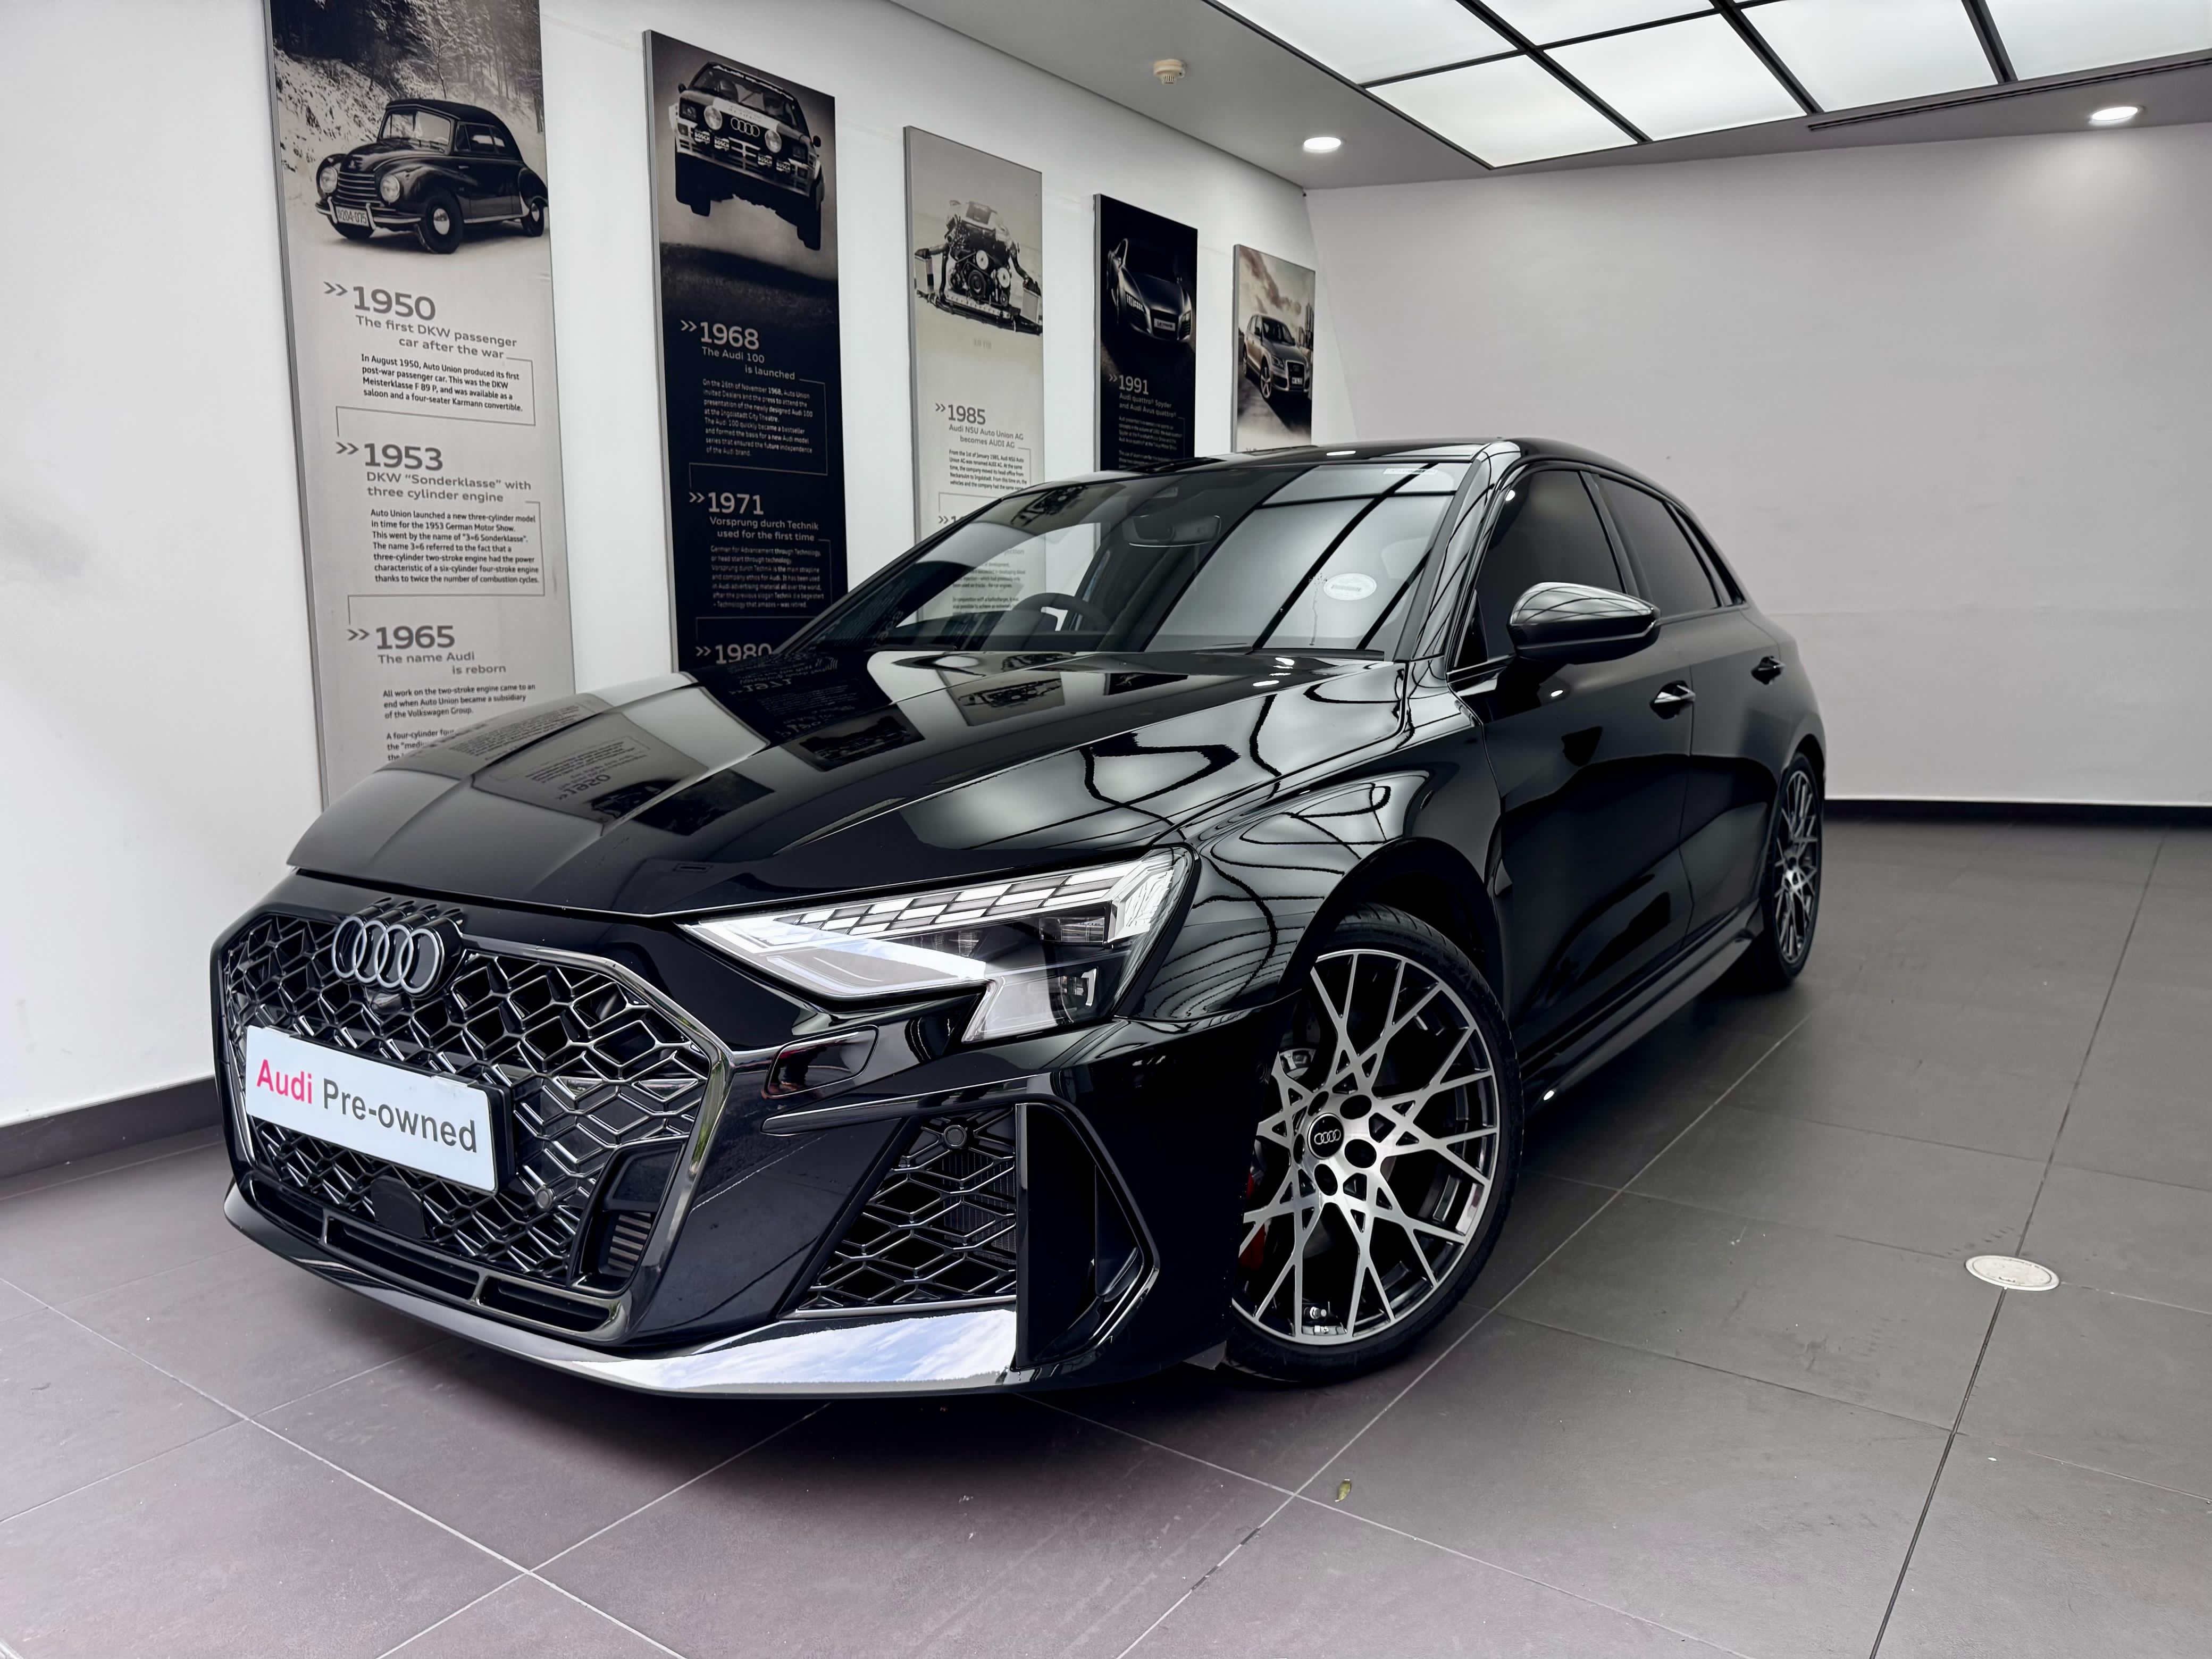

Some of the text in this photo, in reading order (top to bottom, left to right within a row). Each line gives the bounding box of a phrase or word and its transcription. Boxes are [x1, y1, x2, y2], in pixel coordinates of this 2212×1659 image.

[353, 286, 435, 321] 1950
[355, 315, 517, 349] The first DKW passenger
[701, 322, 759, 349] 1968
[399, 338, 504, 359] car after the war
[702, 347, 765, 363] The Audi 100
[371, 355, 398, 367] August
[423, 361, 440, 371] Auto
[441, 364, 462, 373] Union
[464, 366, 495, 379] produced
[506, 371, 519, 380] first
[745, 365, 795, 380] is launched
[363, 376, 413, 389] Meisterklasse
[440, 385, 453, 393] and
[469, 388, 499, 398] available
[397, 371, 433, 382] passenger
[448, 375, 463, 384] This
[479, 378, 490, 387] the
[491, 380, 508, 389] DKW
[1119, 374, 1149, 395] 1991
[364, 388, 388, 397] saloon
[390, 390, 404, 399] and
[452, 397, 483, 407] Karmann
[948, 404, 986, 424] 1985
[949, 423, 963, 432] Audi
[965, 425, 978, 434] NSU
[979, 428, 995, 437] Auto
[996, 429, 1013, 439] Union
[960, 434, 1015, 448] becomes AUDI AG
[364, 442, 443, 470] 1953
[367, 471, 401, 482] DKW
[505, 479, 531, 490] with
[367, 486, 503, 504] three cylinder engine
[708, 492, 764, 514] 1971
[413, 510, 445, 519] launched
[709, 516, 818, 530] Vorsprung durch Technik
[409, 532, 417, 541] by
[465, 554, 487, 564] engine
[517, 565, 539, 574] engine
[376, 625, 455, 649] 1965
[378, 654, 403, 664] The
[446, 651, 475, 661] Audi
[452, 664, 506, 674] is reborn
[476, 684, 499, 694] engine
[438, 697, 459, 705] Union
[460, 696, 487, 704] became
[493, 693, 526, 704] subsidiary
[407, 707, 449, 719] Volkswagen
[393, 730, 438, 740] four-cylinder
[256, 1059, 477, 1153] Audi Pre-owned
